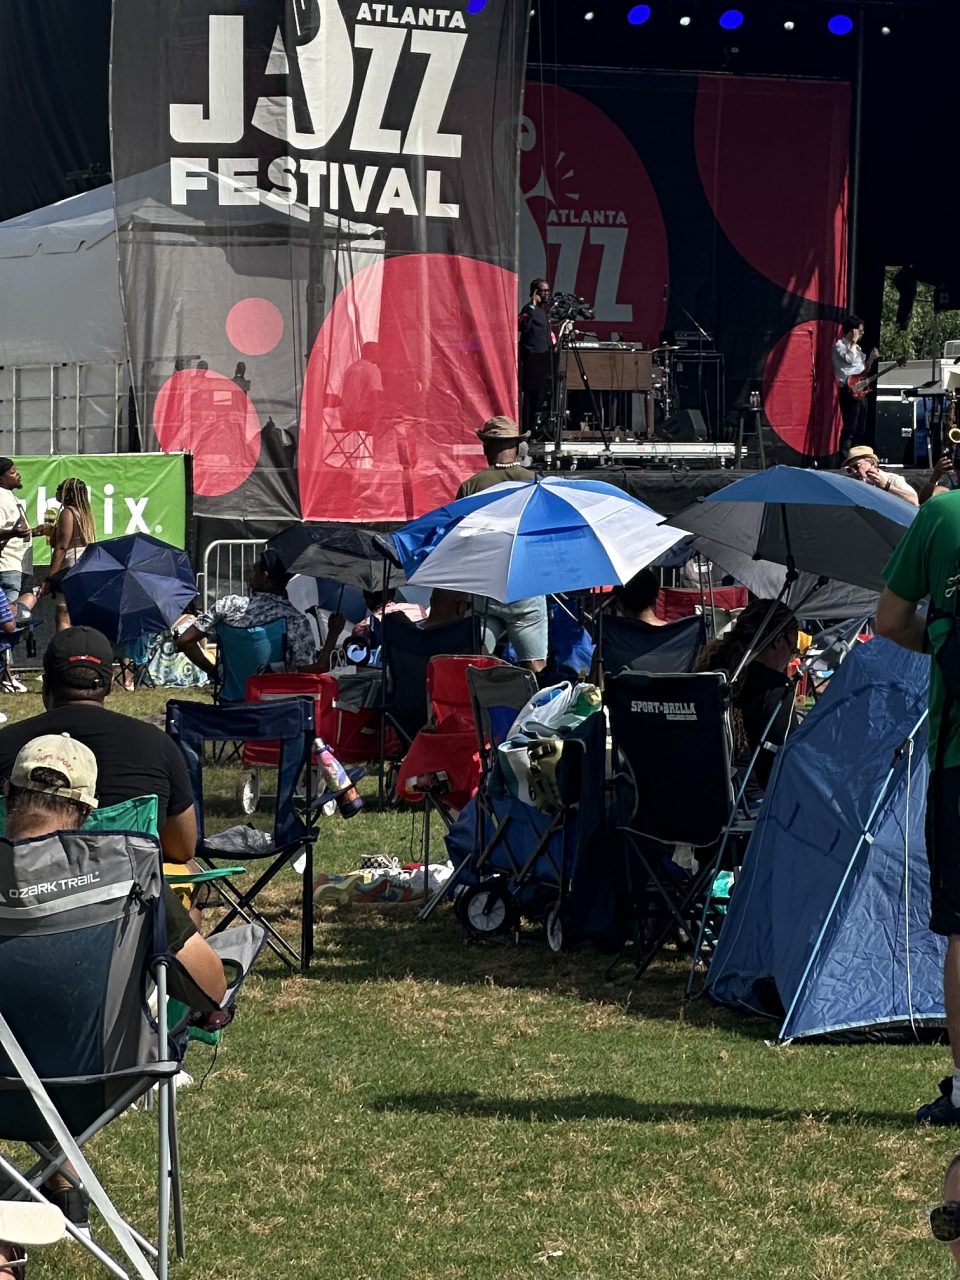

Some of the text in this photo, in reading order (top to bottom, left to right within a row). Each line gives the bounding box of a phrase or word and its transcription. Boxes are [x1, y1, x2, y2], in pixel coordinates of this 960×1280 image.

[356, 2, 467, 29] ATLANTA
[169, 14, 469, 159] JAZZ
[169, 155, 460, 219] FESTIVAL
[548, 209, 628, 225] ATLANTA
